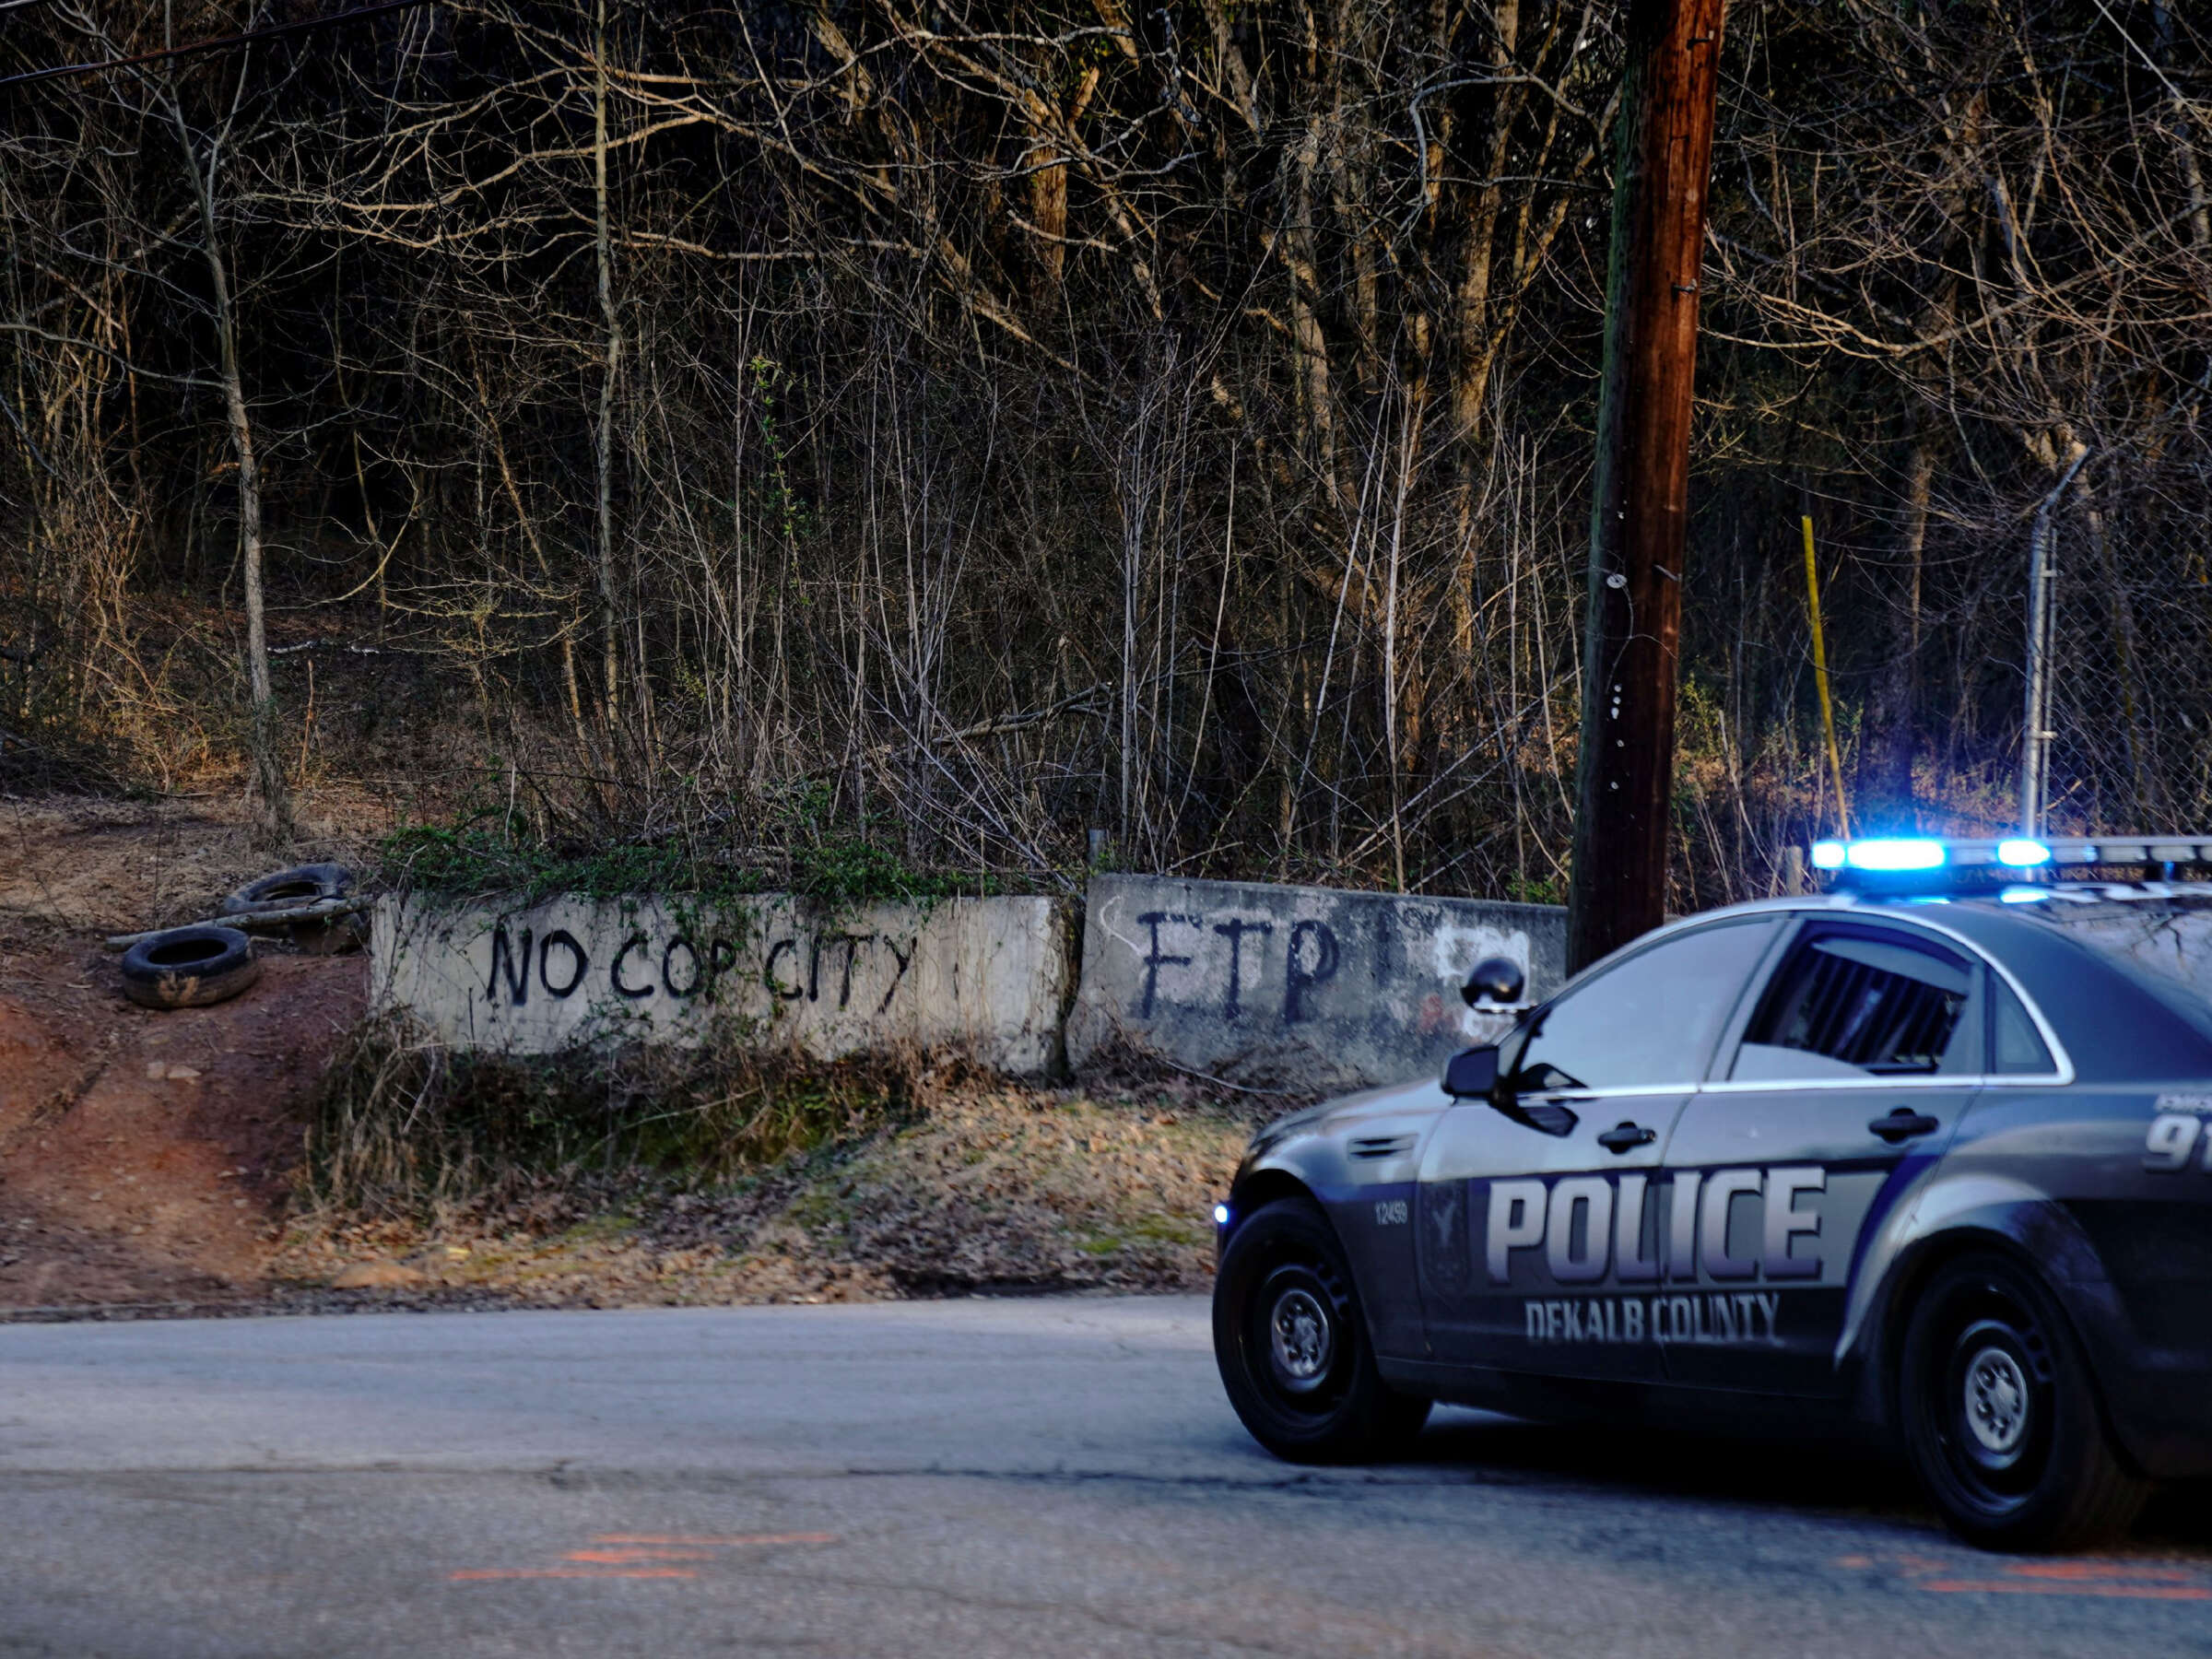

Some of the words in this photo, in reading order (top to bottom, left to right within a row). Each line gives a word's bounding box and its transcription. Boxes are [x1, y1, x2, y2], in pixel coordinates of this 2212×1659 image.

[487, 922, 588, 1006] NO
[609, 931, 735, 1003] COP
[765, 933, 918, 1013] CITY
[1136, 910, 1340, 1023] FTP
[1486, 1167, 1825, 1283] POLICE
[1525, 1299, 1645, 1343] DEKALB
[1652, 1292, 1780, 1344] COUNTY
